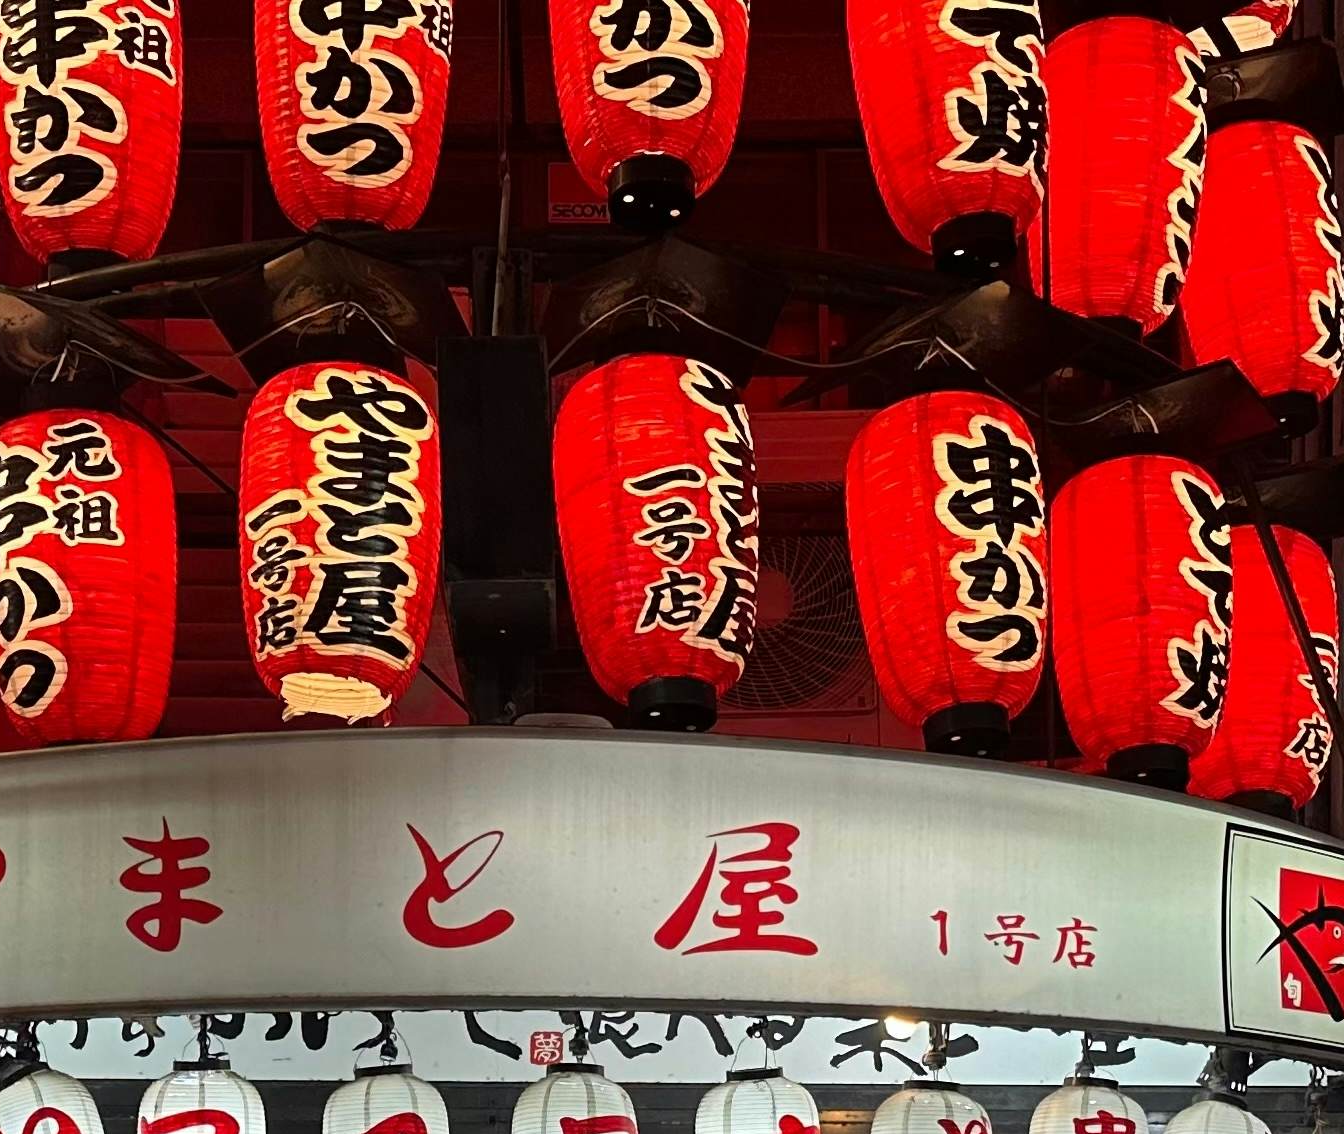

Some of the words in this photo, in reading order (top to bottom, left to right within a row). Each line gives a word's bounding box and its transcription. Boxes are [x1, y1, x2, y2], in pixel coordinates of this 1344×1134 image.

[551, 203, 608, 219] SECOM
[47, 421, 120, 543] 元祖
[293, 374, 431, 666] やまと屋
[629, 468, 707, 630] 一号店
[938, 424, 1044, 664] 串かつ
[250, 498, 308, 653] 一号店
[929, 909, 1098, 970] 1号店
